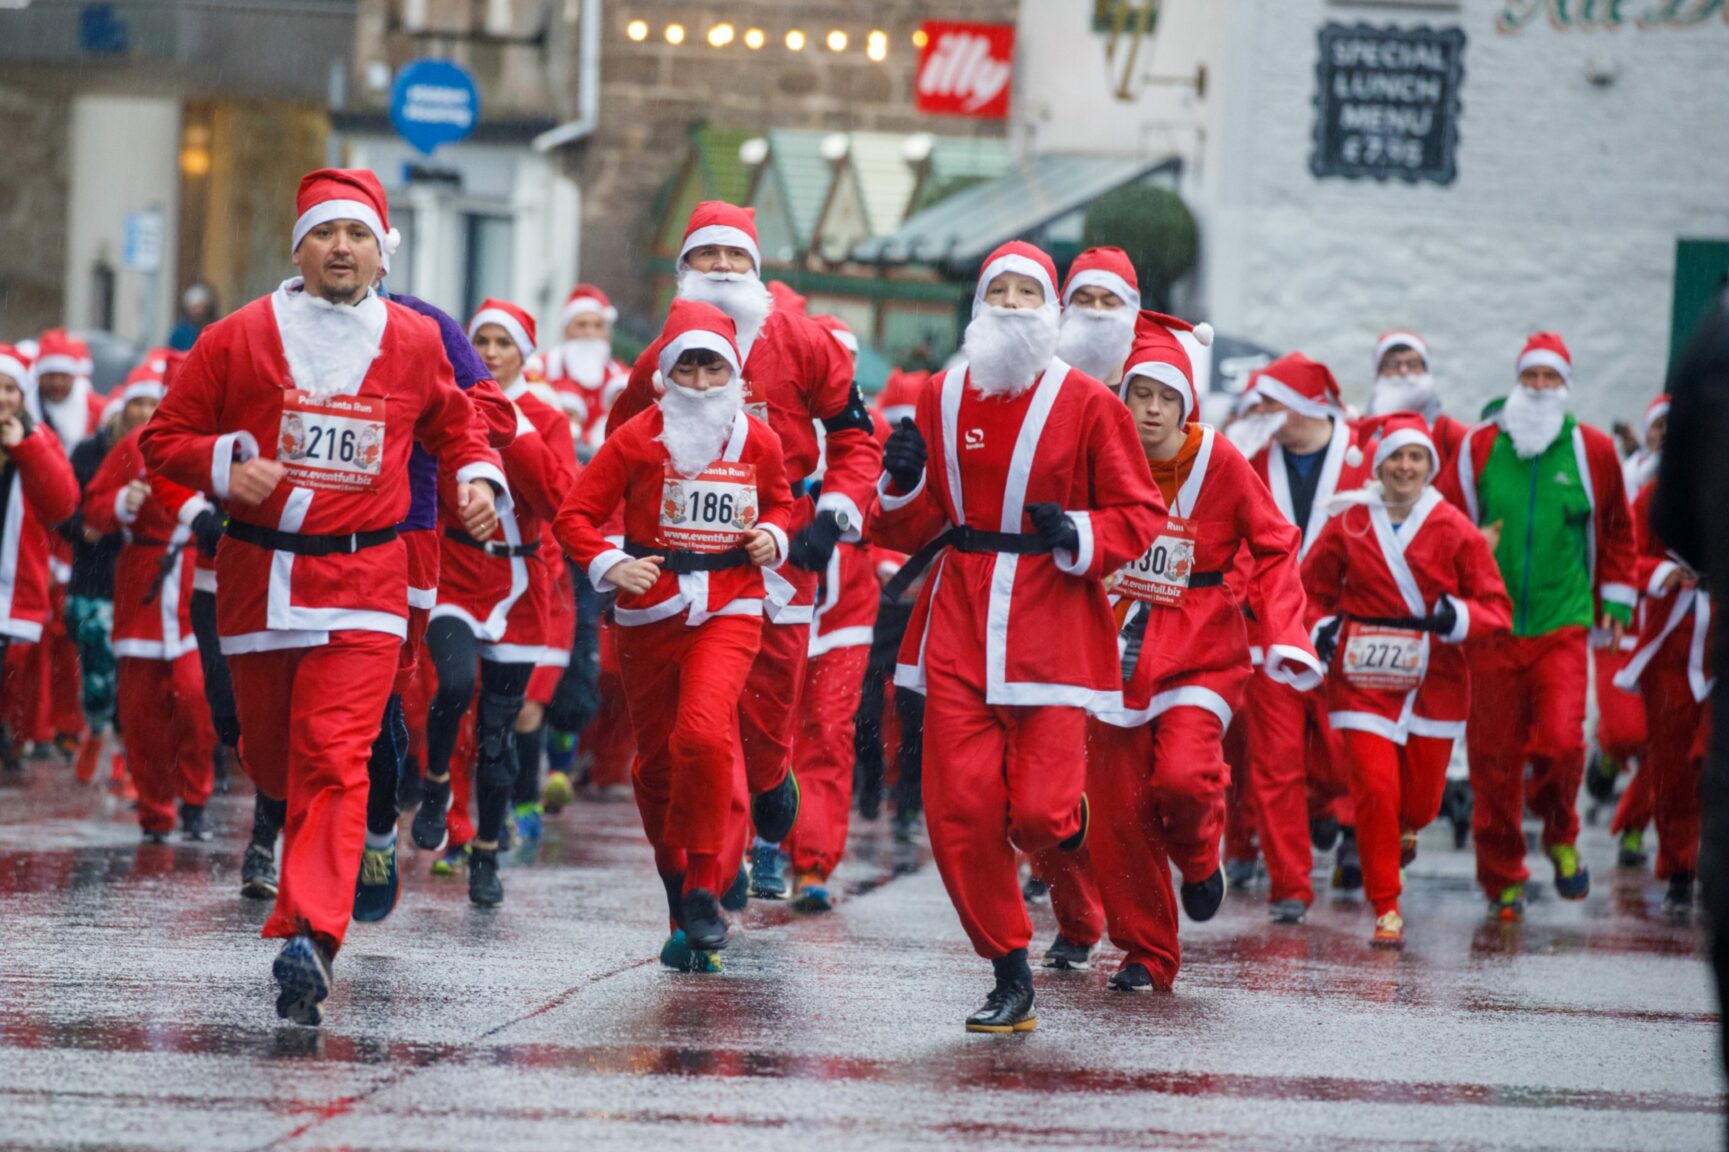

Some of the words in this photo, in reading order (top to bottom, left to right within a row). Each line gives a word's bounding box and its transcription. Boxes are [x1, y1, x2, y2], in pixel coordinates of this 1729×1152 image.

[1331, 39, 1443, 69] SPECIAL
[919, 32, 1009, 111] illy
[1333, 72, 1442, 102] LUNCH
[1340, 104, 1433, 135] MENU
[324, 401, 352, 411] Santa
[354, 403, 372, 413] Run
[306, 425, 355, 462] 216
[729, 467, 745, 477] Run
[690, 491, 733, 523] 186
[1167, 521, 1184, 532] Run
[1365, 643, 1402, 669] 272
